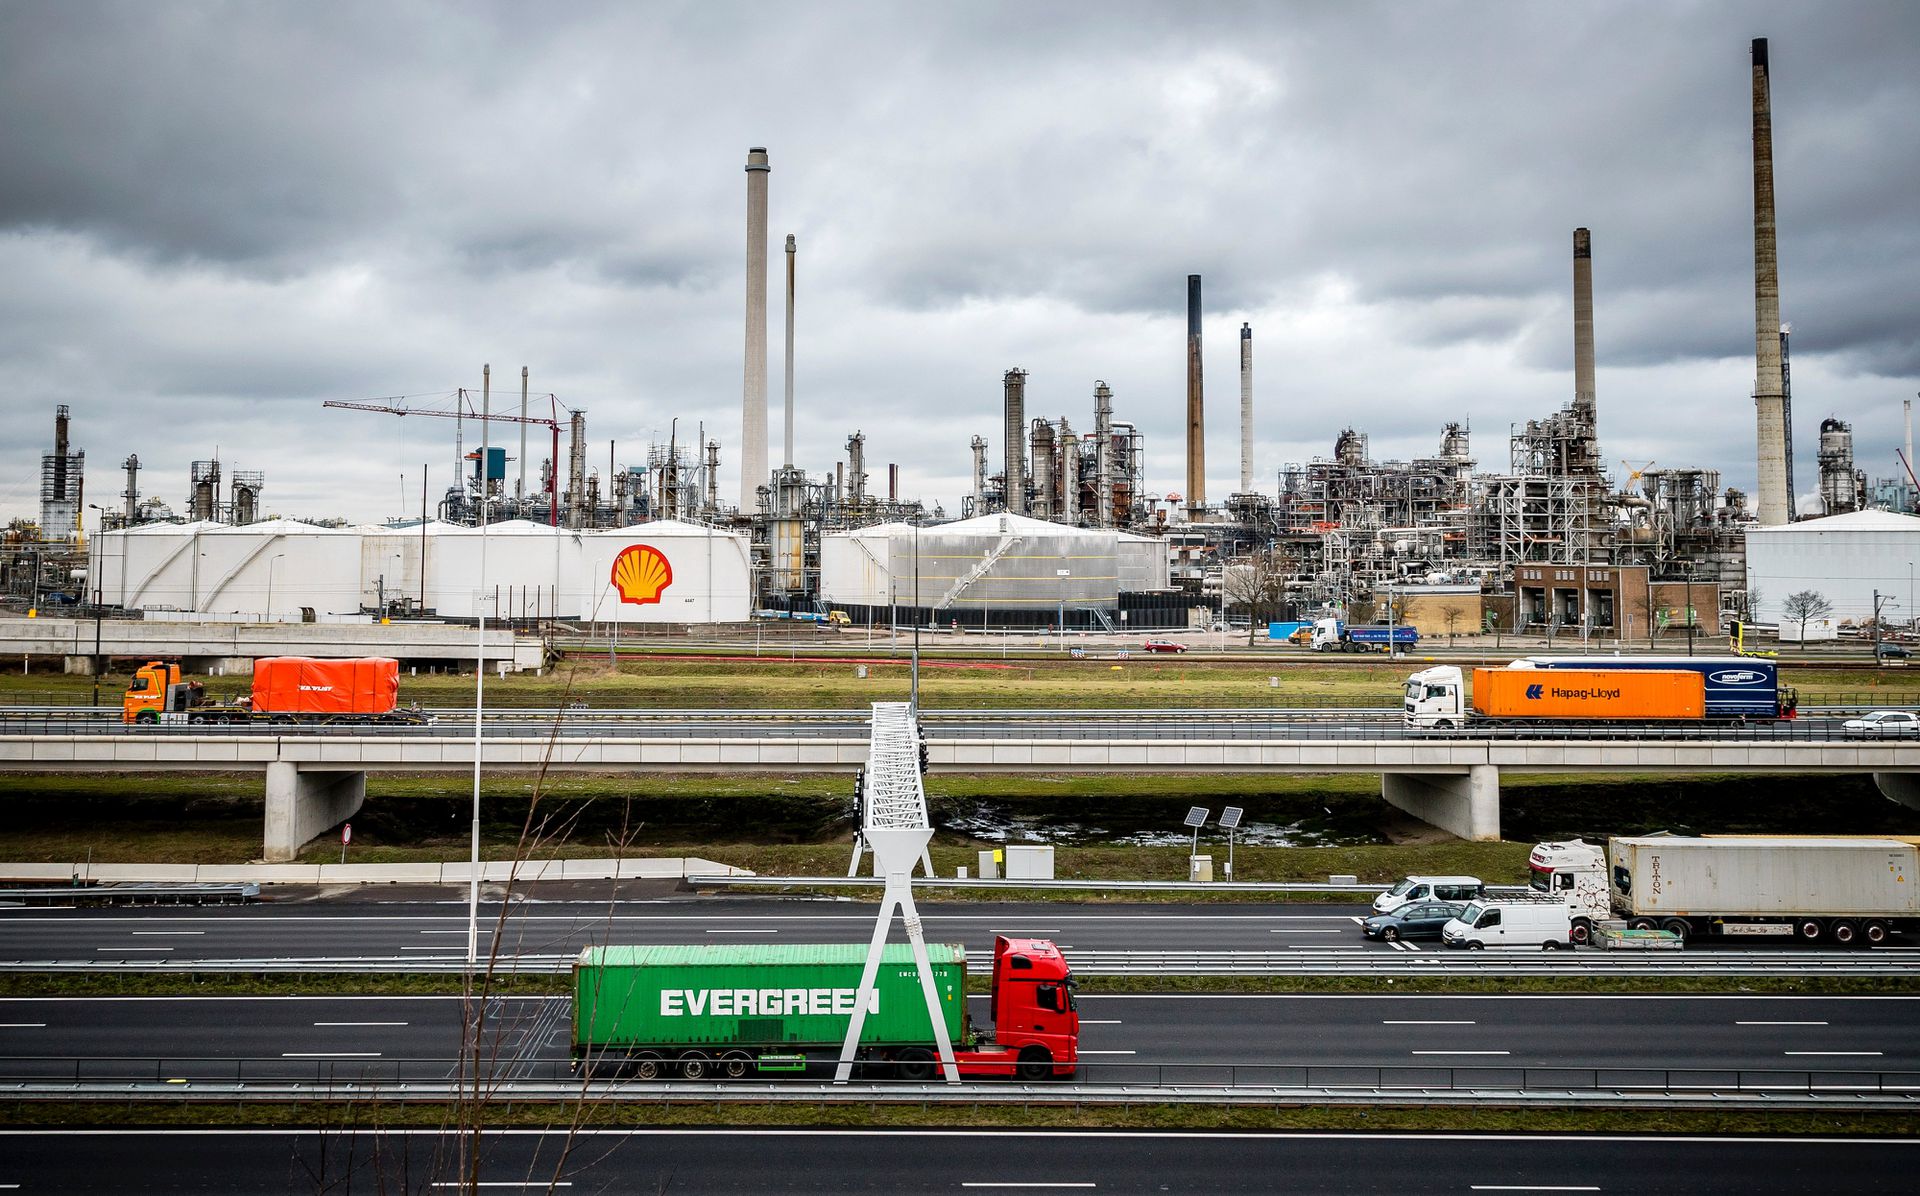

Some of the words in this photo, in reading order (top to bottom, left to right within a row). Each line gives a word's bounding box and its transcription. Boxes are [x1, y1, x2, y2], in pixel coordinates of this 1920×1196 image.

[1551, 687, 1620, 700] Hapag-Lloyd
[1651, 856, 1662, 895] TRITON
[660, 988, 880, 1016] EVERGREEN
